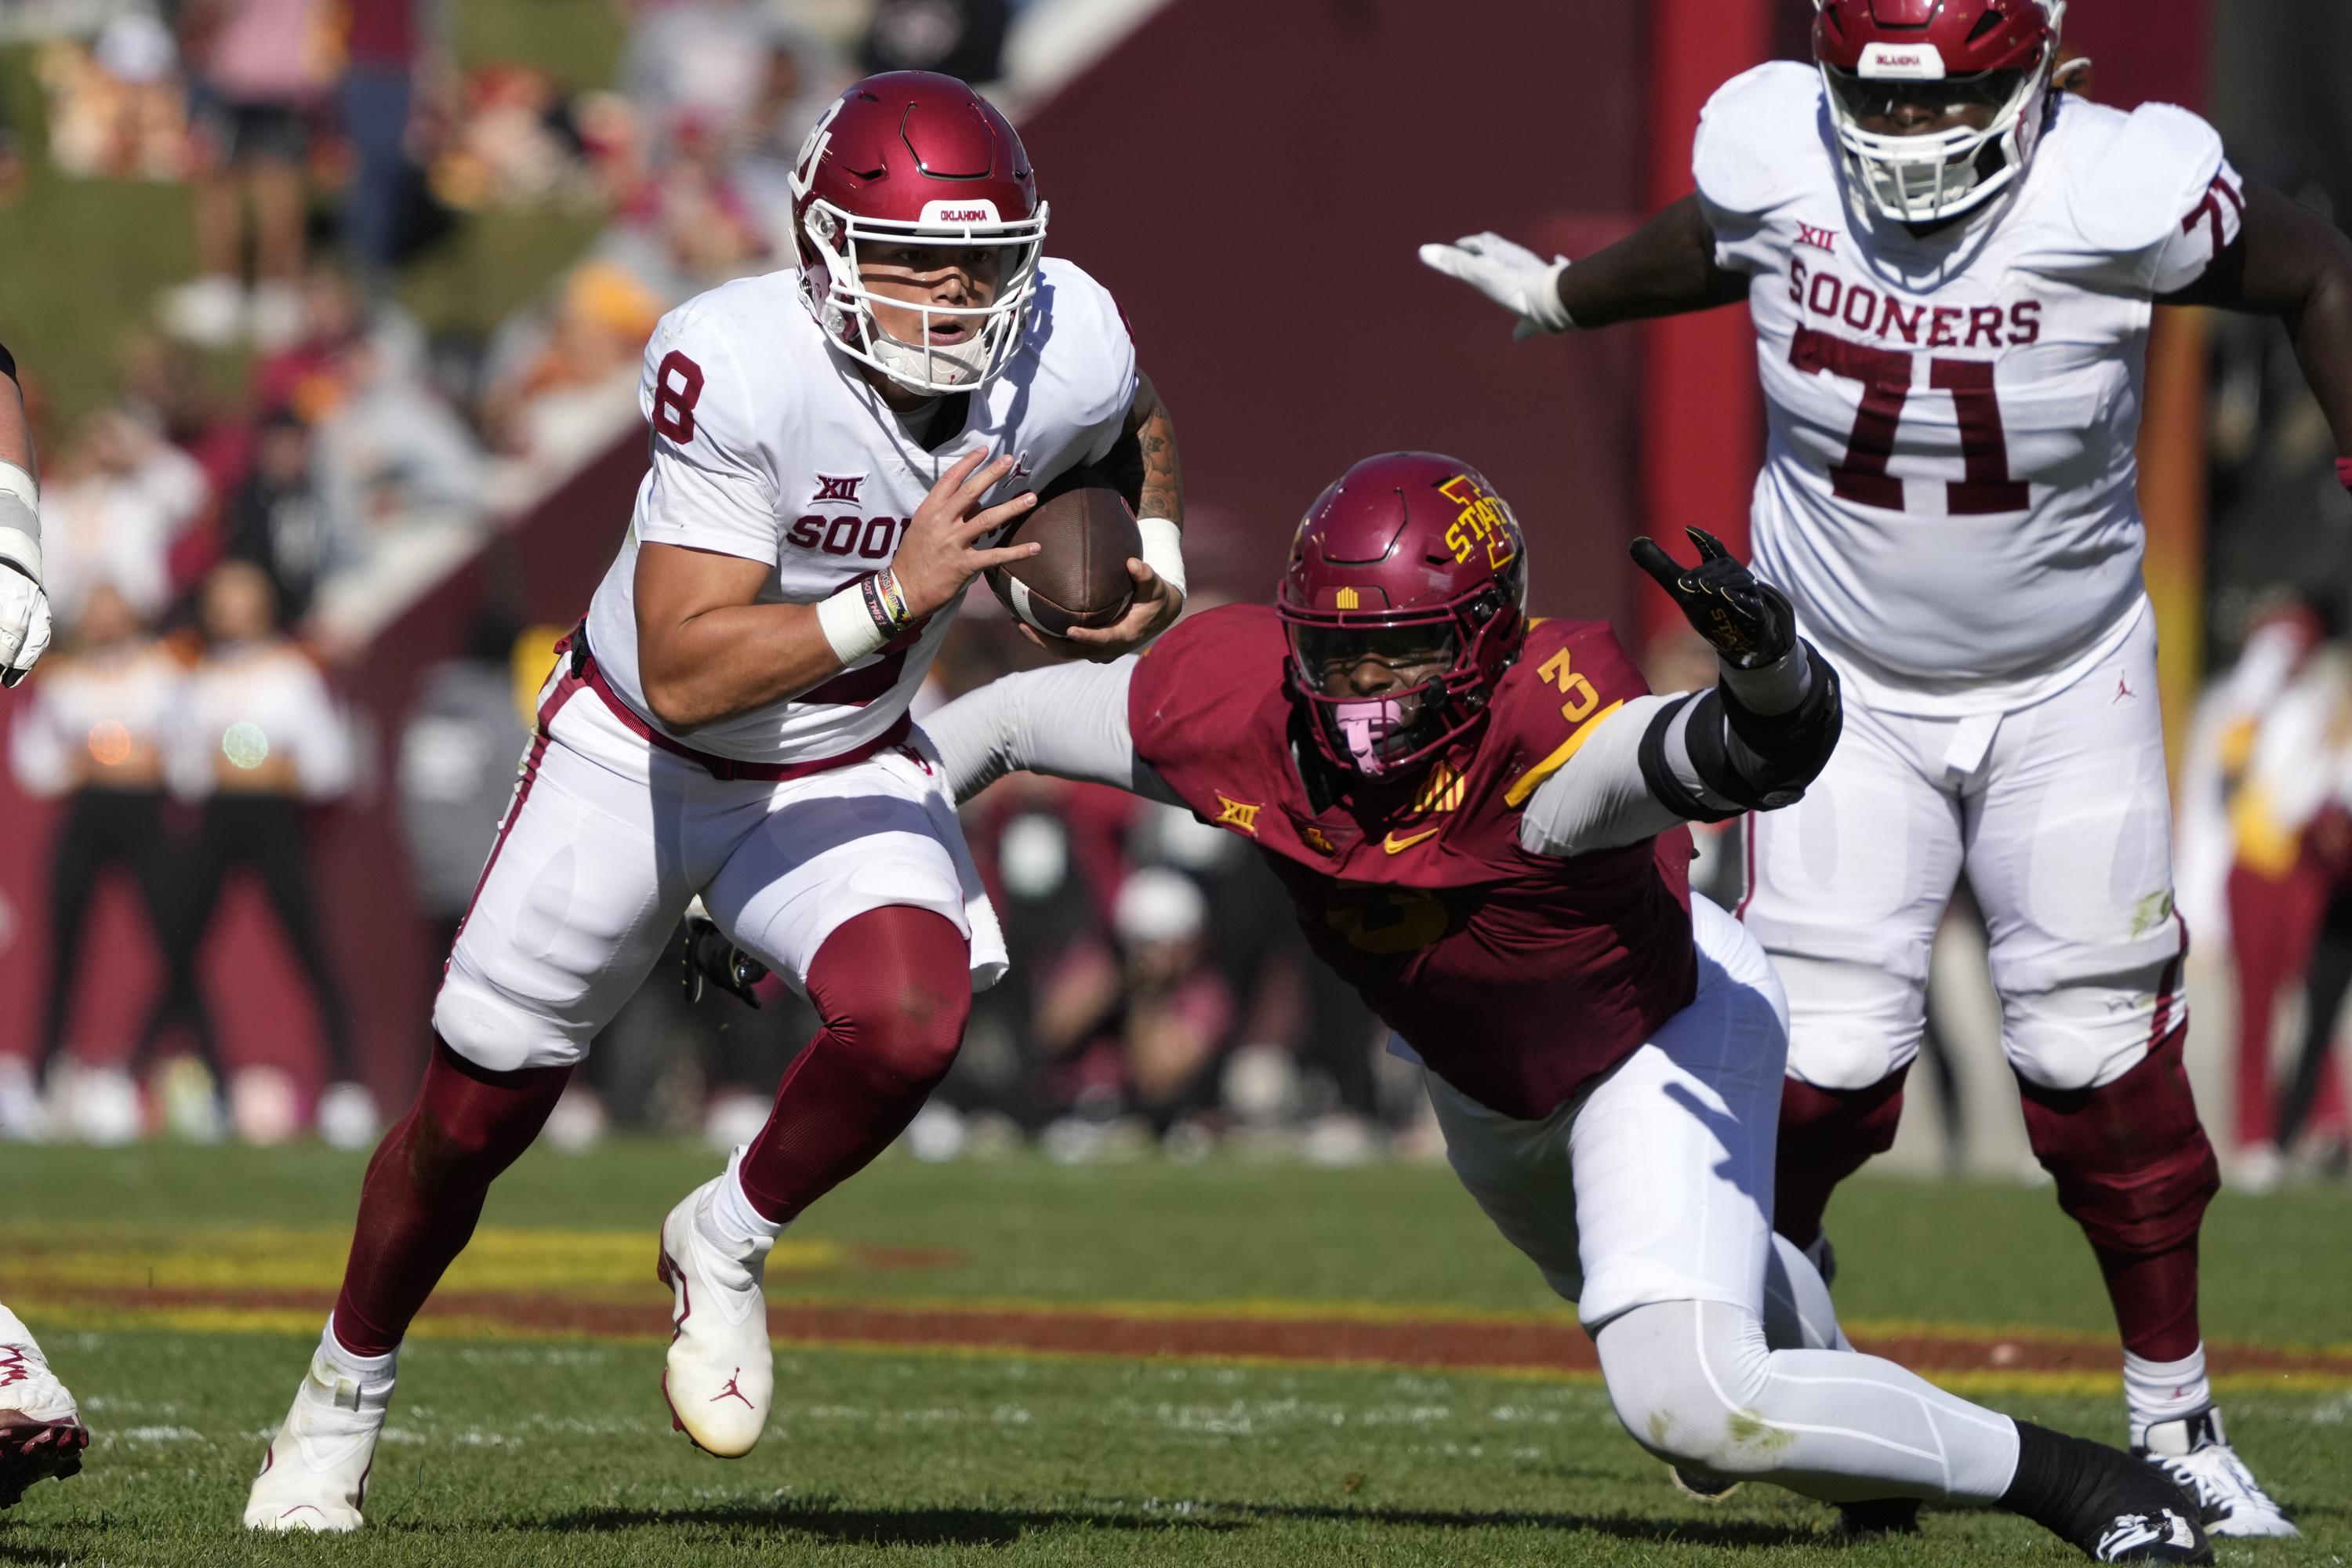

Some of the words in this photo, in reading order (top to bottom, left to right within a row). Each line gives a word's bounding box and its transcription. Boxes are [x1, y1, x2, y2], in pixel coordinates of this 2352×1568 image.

[940, 209, 988, 221] OKLAHOMA
[1794, 220, 1839, 253] XII
[1789, 257, 2042, 347] SOONERS
[653, 350, 705, 445] 8
[1788, 321, 2031, 516] 71
[812, 474, 863, 502] XII
[1537, 646, 1599, 723] 3
[1215, 794, 1261, 833] XII
